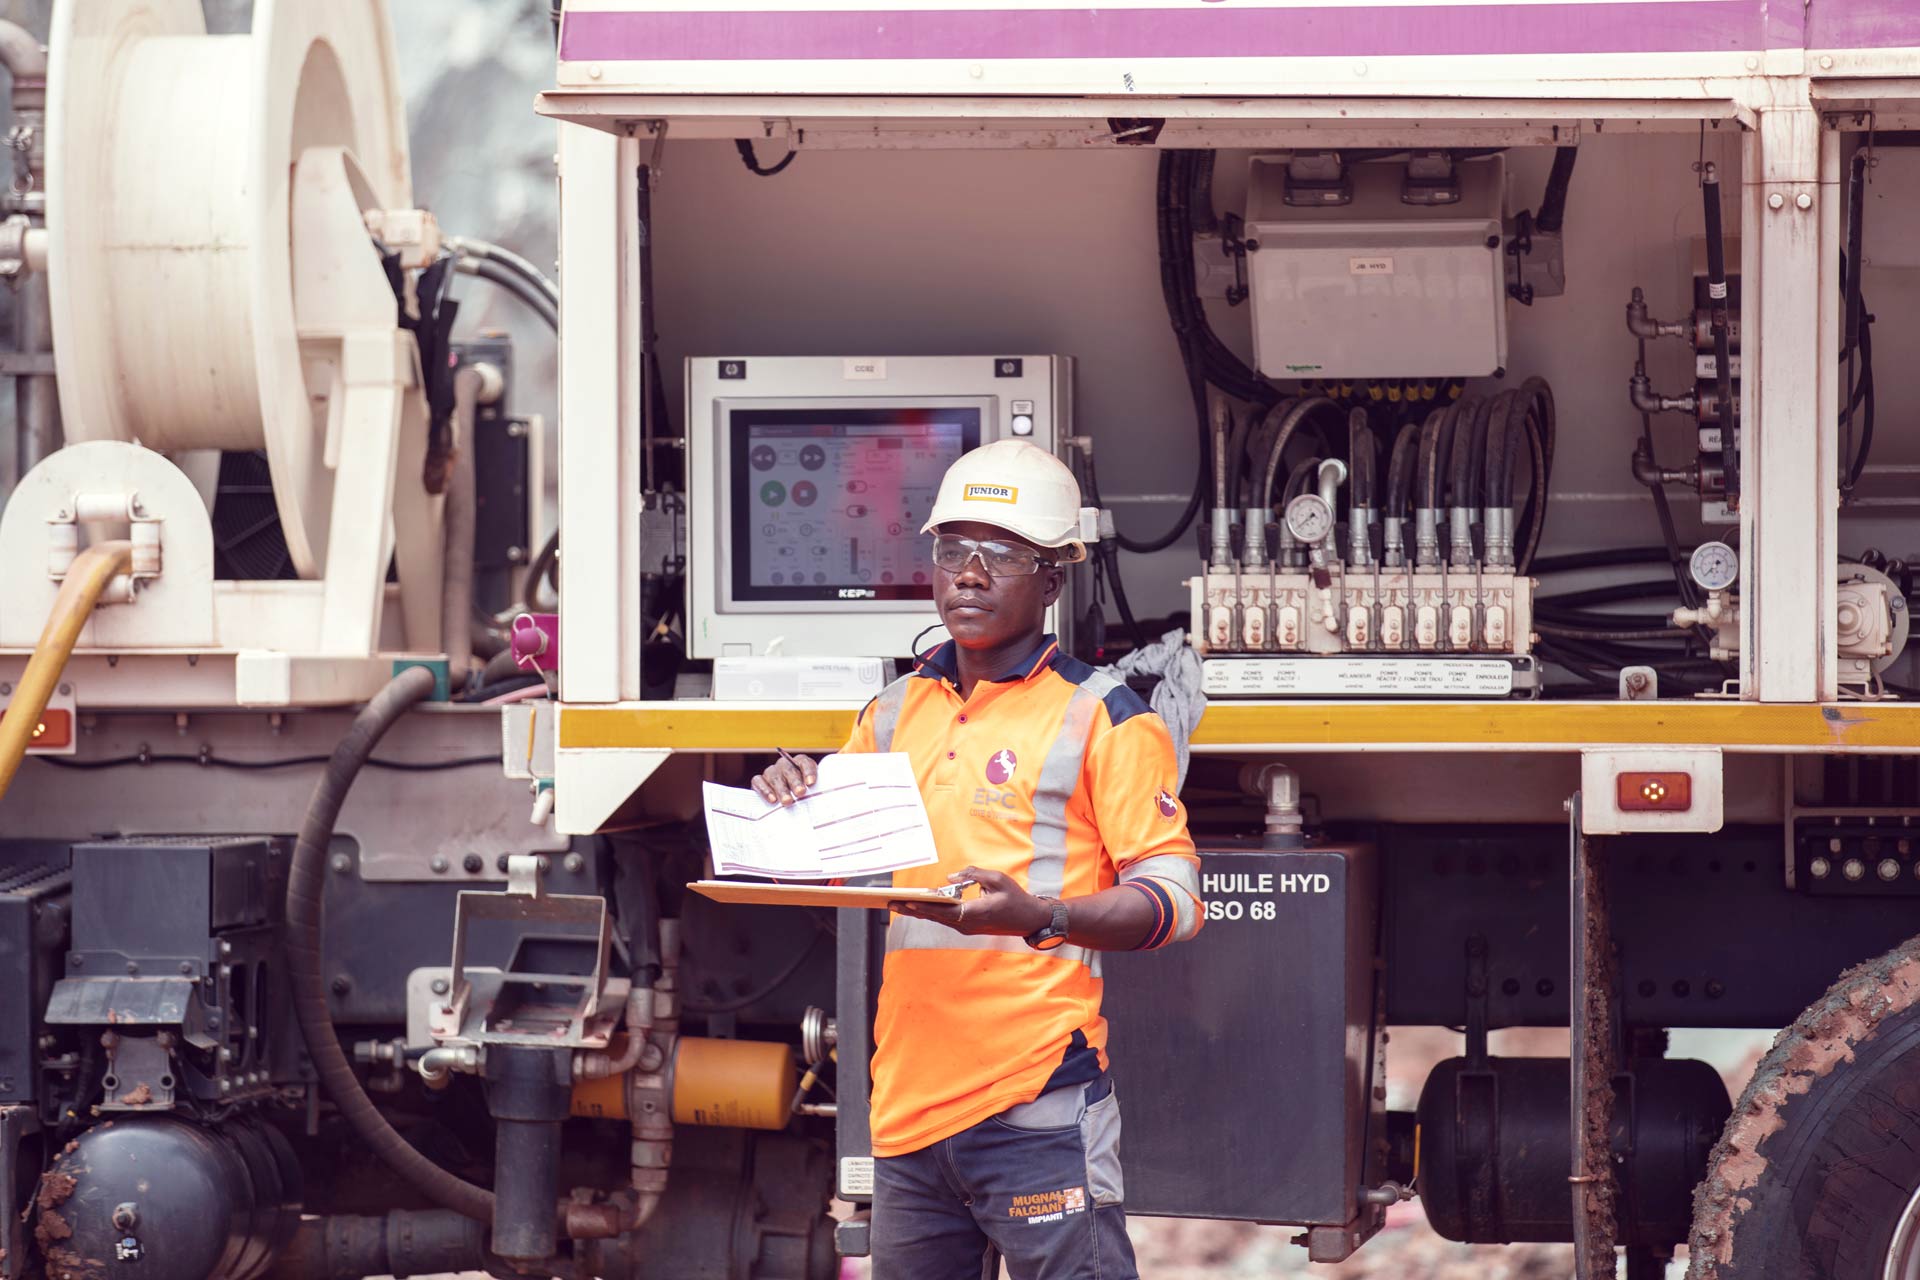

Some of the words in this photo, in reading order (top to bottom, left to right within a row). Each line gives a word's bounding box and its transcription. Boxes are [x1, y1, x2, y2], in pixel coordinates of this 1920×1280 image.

[969, 487, 1009, 497] JUNIOR
[973, 787, 1017, 809] EPC
[1203, 874, 1273, 893] HUILE
[1281, 874, 1330, 893] HYD
[1204, 901, 1244, 920] ISO
[1250, 901, 1277, 920] 68
[1008, 1202, 1063, 1217] FALCIANI
[1028, 1212, 1063, 1225] IMPIANTI
